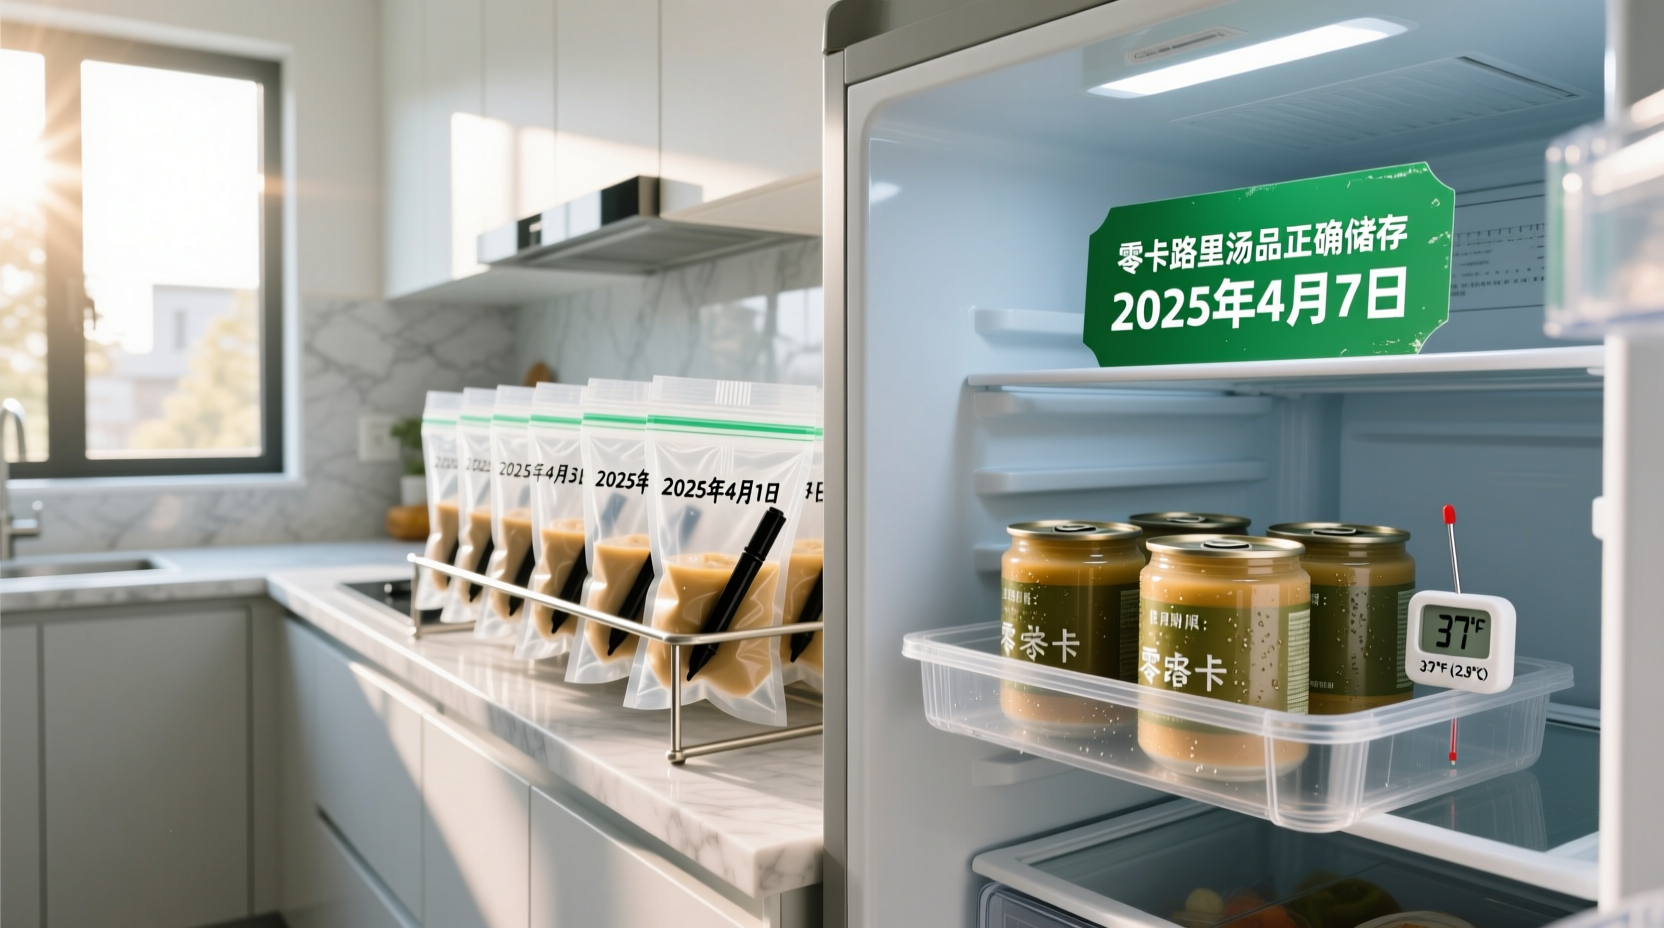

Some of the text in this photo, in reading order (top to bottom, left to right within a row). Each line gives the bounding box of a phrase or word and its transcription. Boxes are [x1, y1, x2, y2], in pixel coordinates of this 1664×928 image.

[1118, 213, 1408, 274] 零卡路里汤品正确储存
[1111, 266, 1407, 331] 2025年4月7日
[661, 476, 780, 505] 2025年4月1日
[1436, 614, 1486, 650] 37°F
